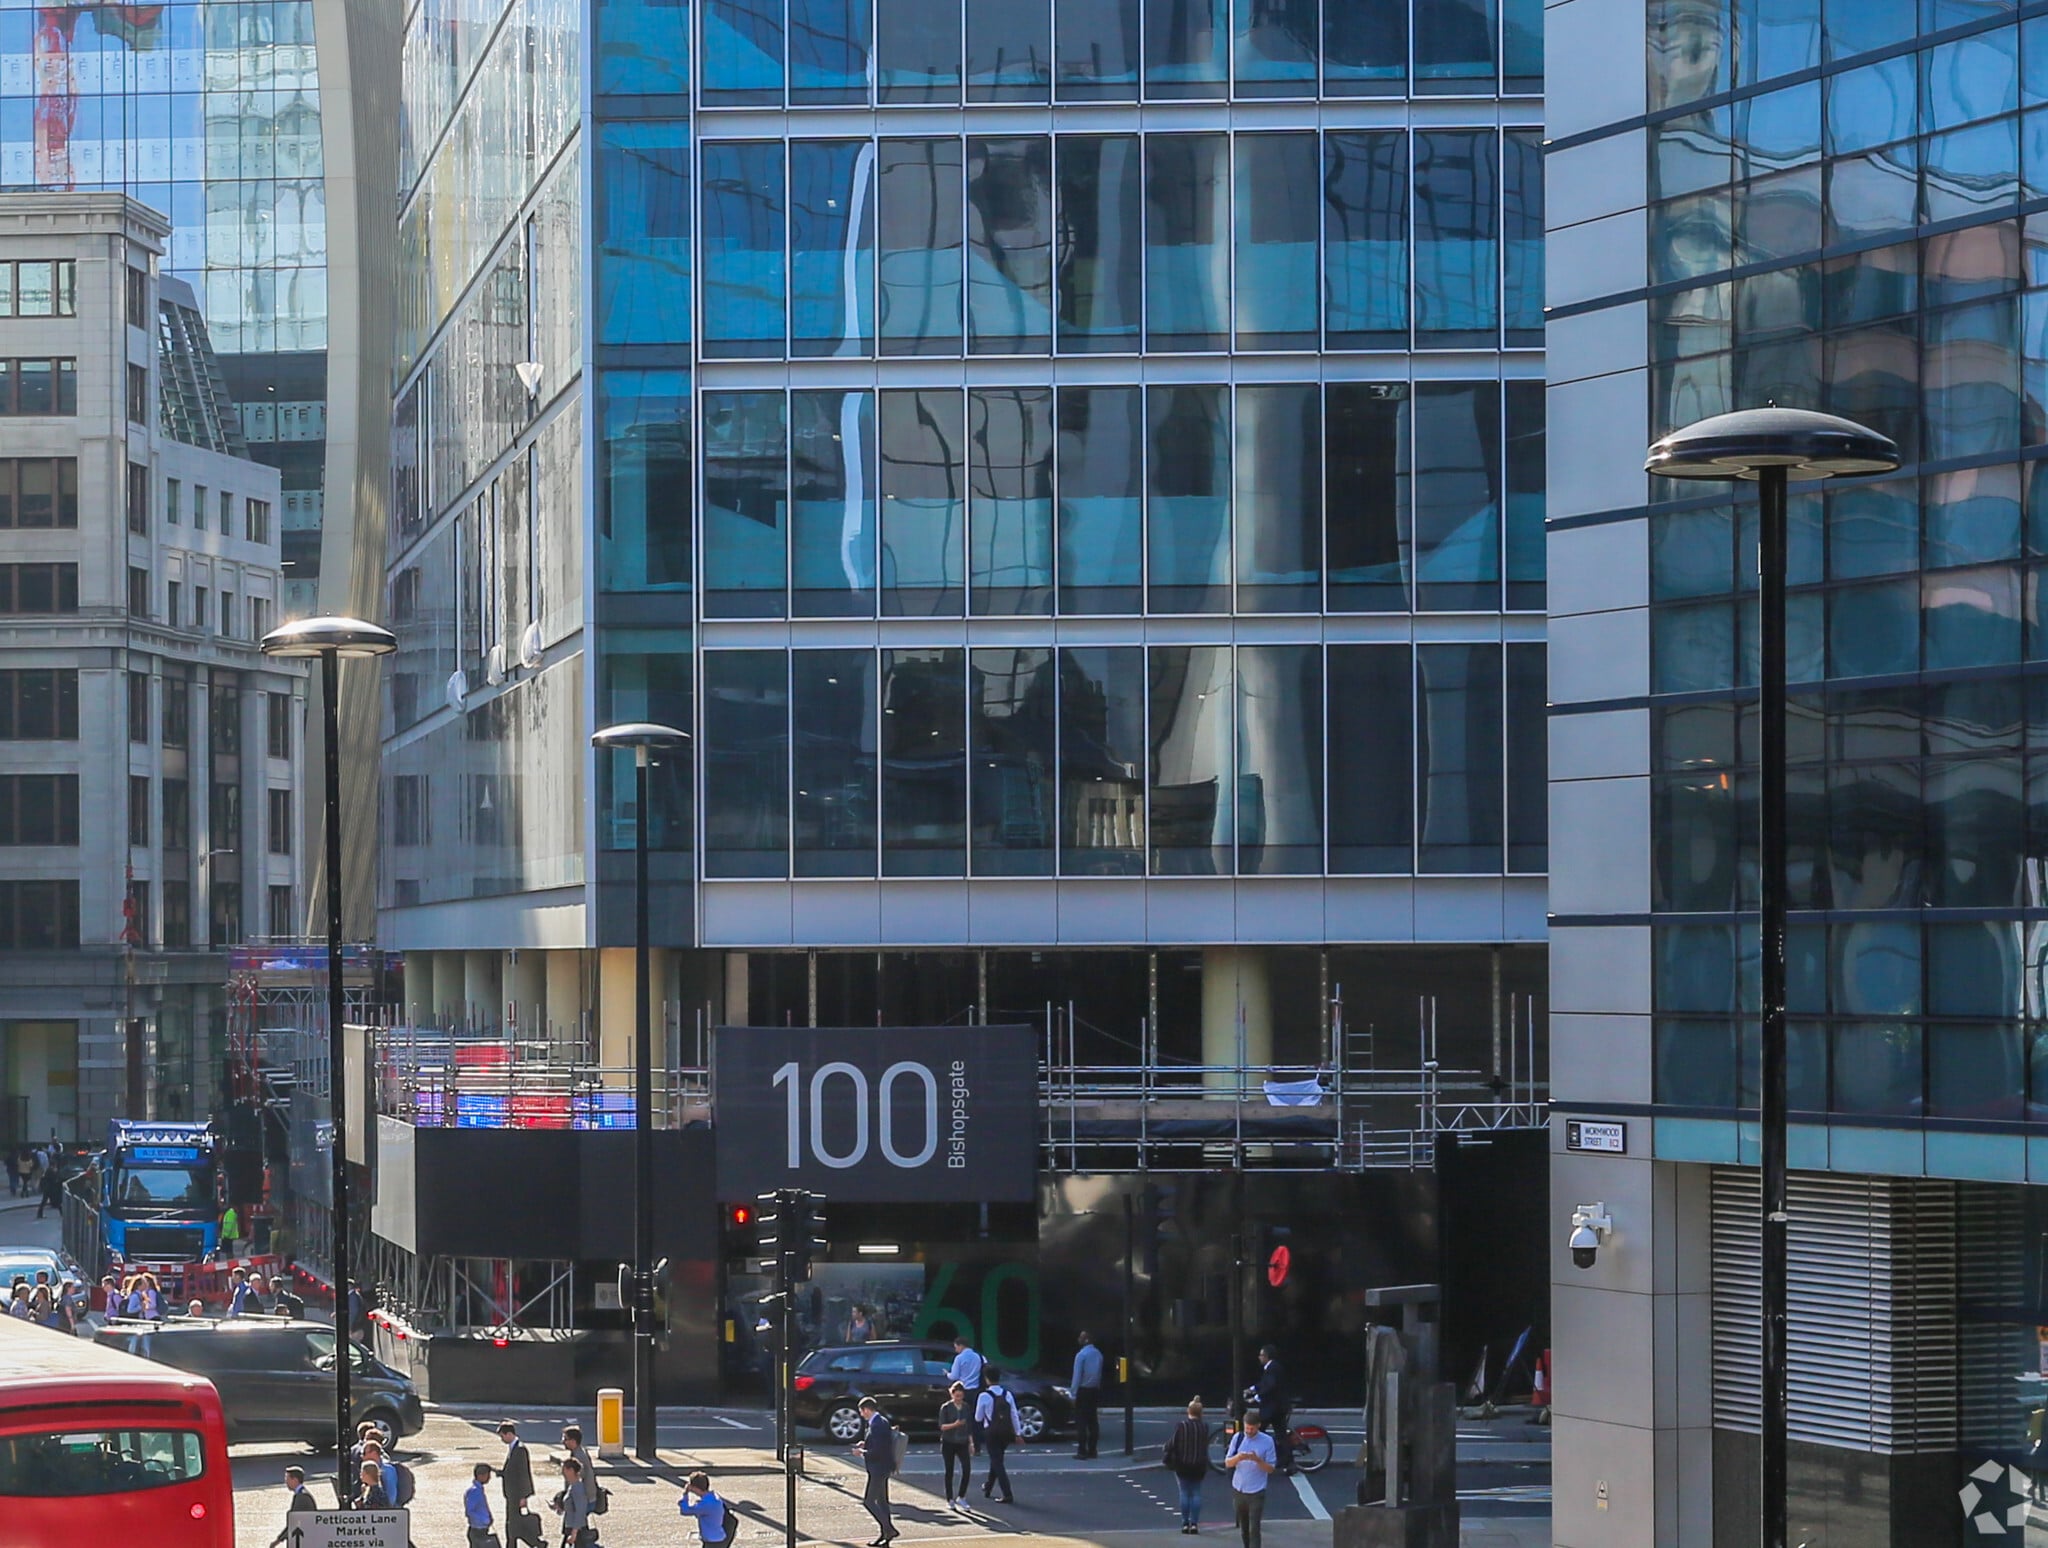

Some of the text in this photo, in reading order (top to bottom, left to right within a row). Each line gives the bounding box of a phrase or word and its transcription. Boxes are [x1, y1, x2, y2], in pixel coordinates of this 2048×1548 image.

[772, 1060, 938, 1169] 100
[948, 1060, 970, 1168] Bishopsgate
[315, 1514, 397, 1525] Petticoat Lane
[336, 1526, 376, 1537] Market
[327, 1537, 384, 1548] access via
